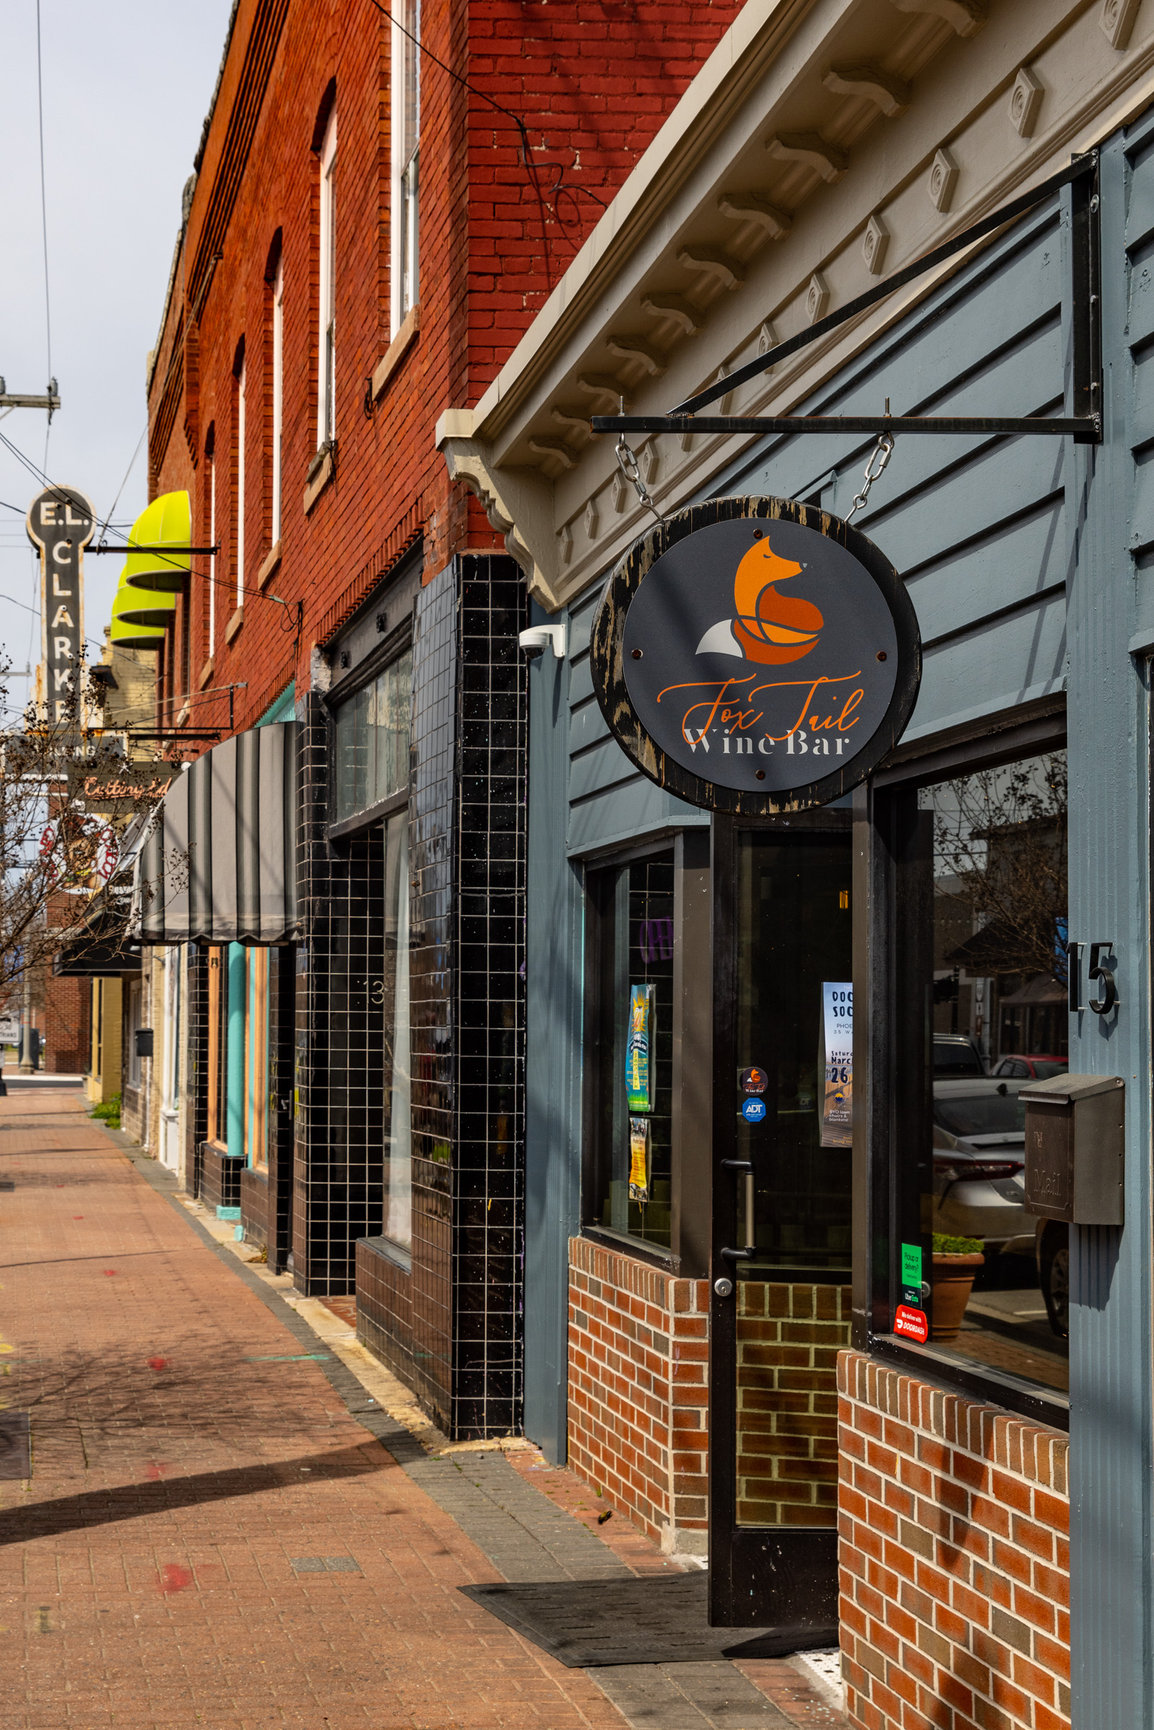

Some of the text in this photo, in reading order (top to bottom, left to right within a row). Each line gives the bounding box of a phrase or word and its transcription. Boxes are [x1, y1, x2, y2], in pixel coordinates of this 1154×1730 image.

[51, 540, 75, 724] CLARKE
[656, 669, 865, 745] Fox Tail
[683, 727, 850, 755] Wine Bar
[1065, 941, 1116, 1015] 15
[831, 1067, 848, 1083] 26
[745, 1104, 763, 1113] ADT
[1033, 1168, 1061, 1197] Mail
